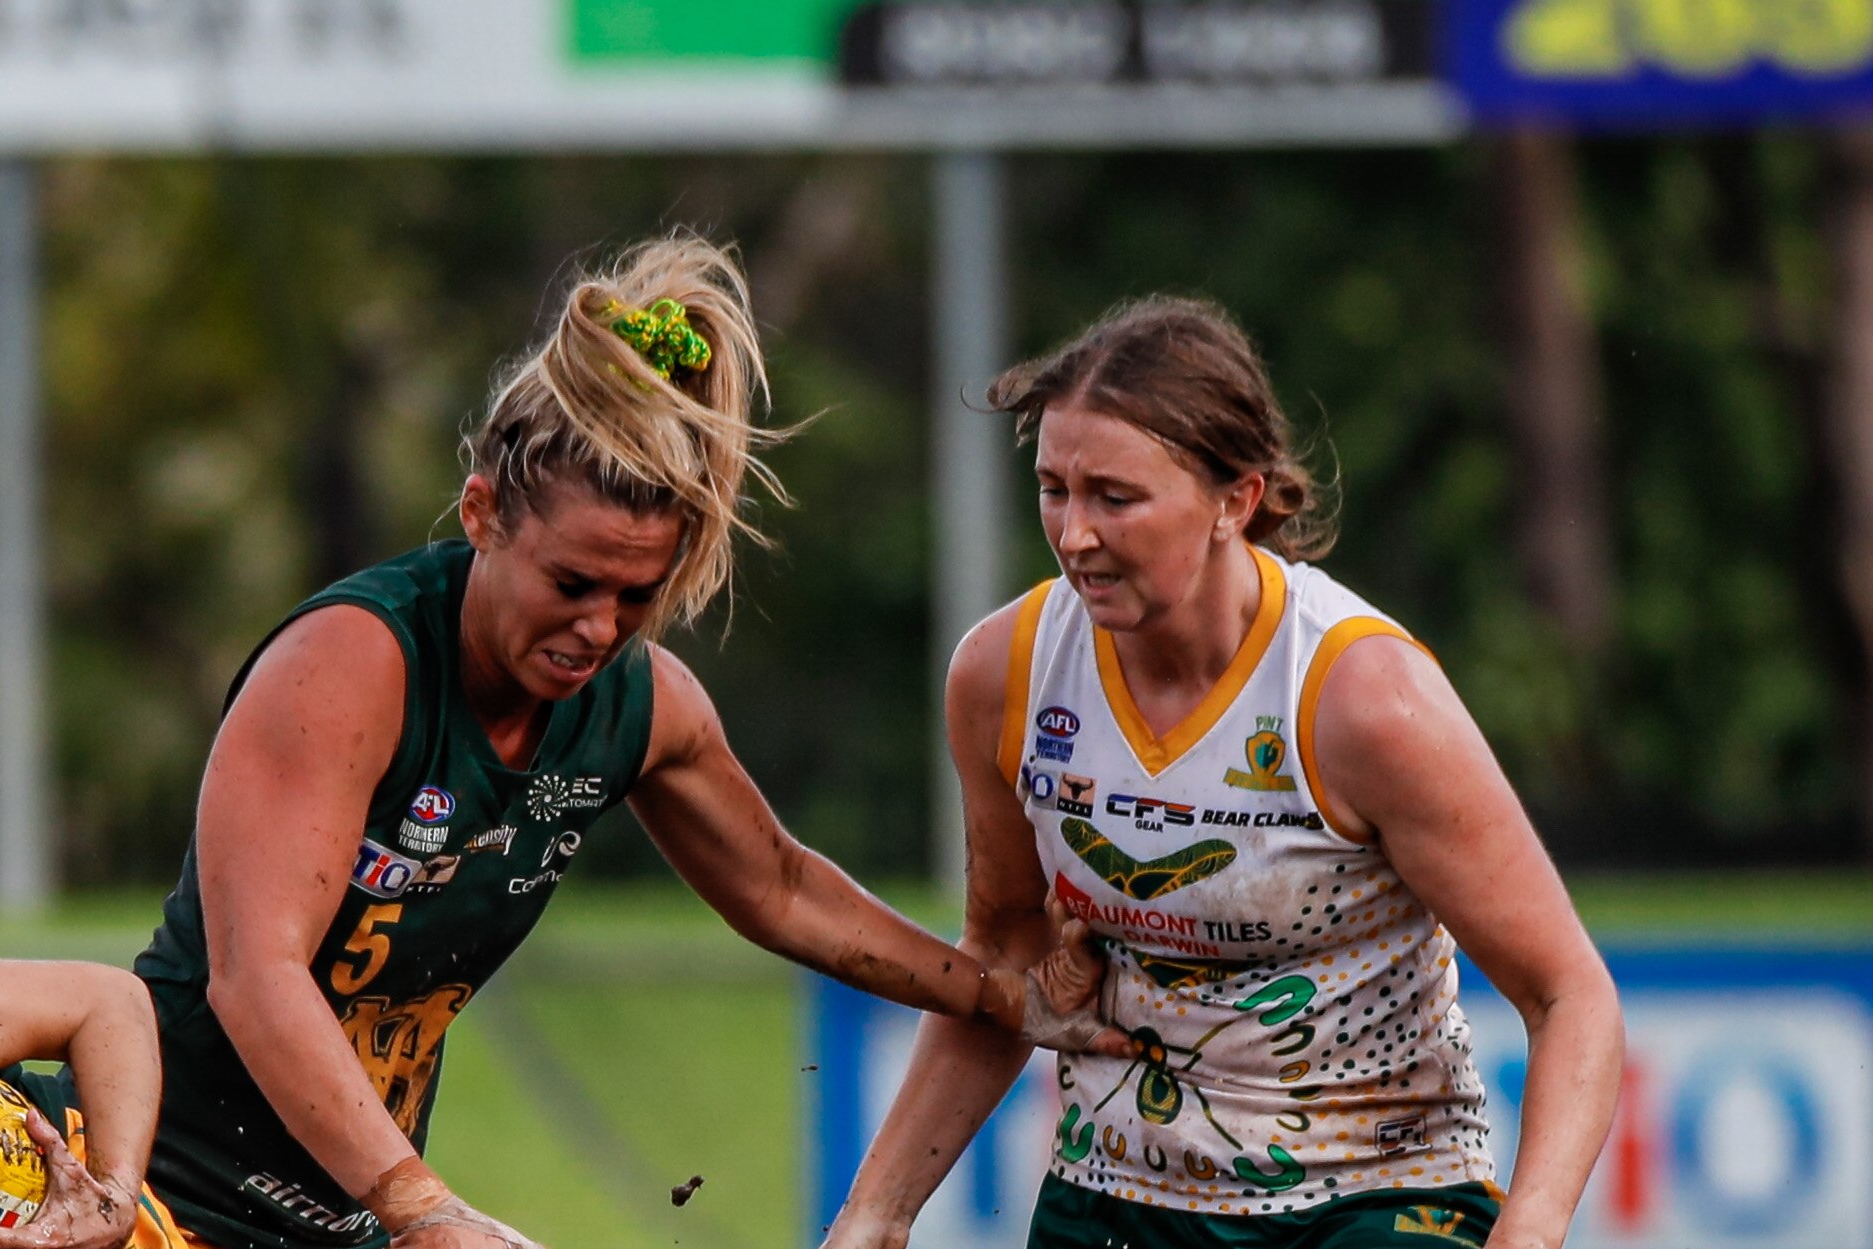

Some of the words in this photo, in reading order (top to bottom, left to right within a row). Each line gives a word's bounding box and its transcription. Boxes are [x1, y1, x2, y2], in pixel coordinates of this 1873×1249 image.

[1041, 712, 1076, 733] AFL
[1105, 793, 1197, 827] CFS
[1201, 808, 1251, 827] BEAR
[1135, 819, 1164, 833] GEAR
[1066, 895, 1197, 937] BEAUMONT
[1203, 920, 1272, 943] TILES
[330, 903, 404, 996] 5
[1123, 930, 1222, 958] DARWIN
